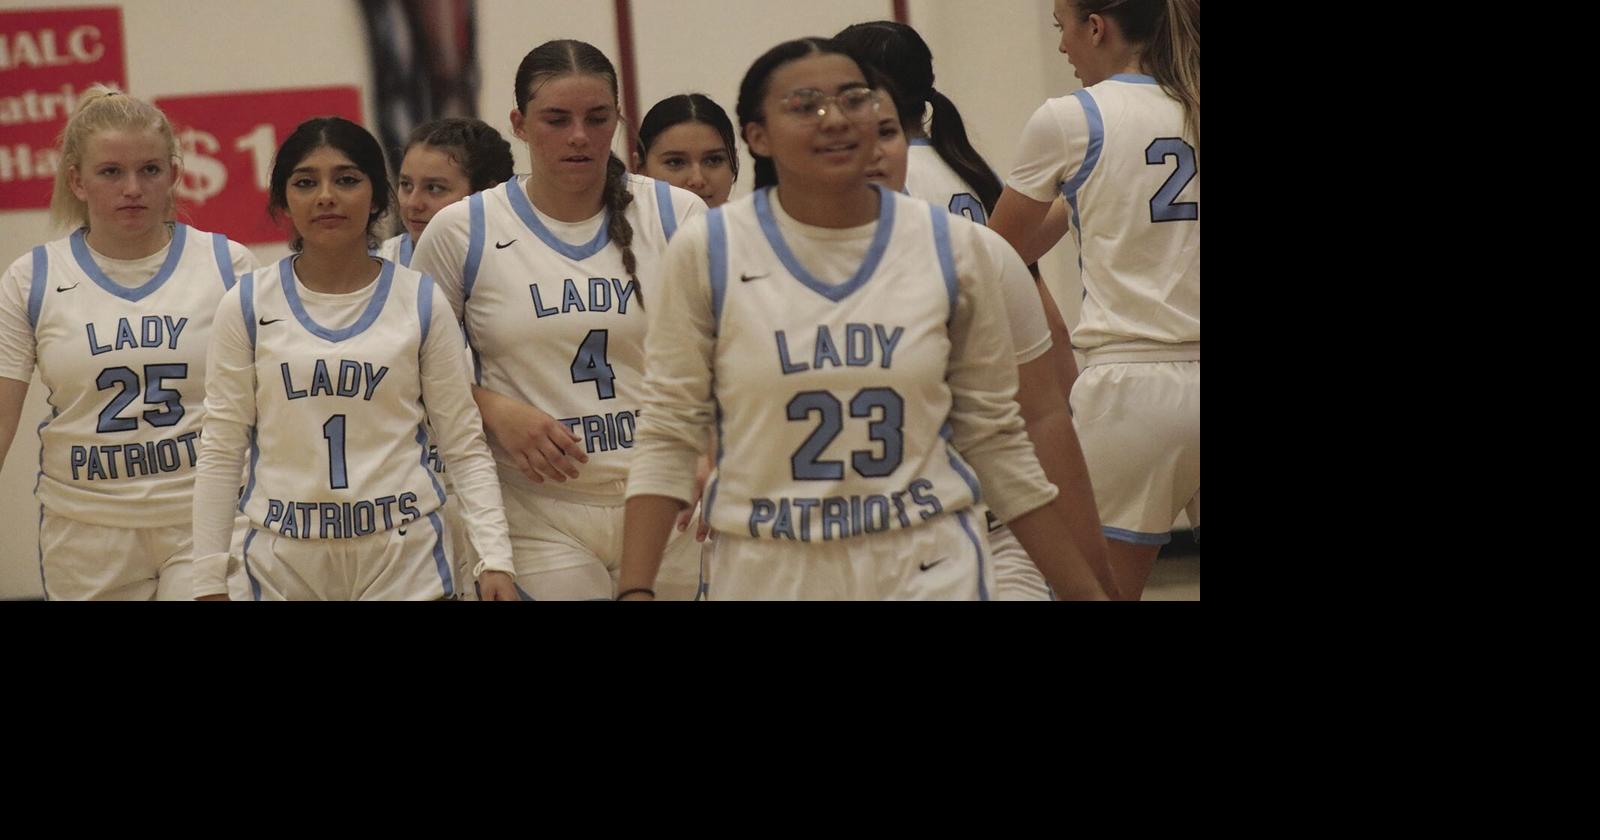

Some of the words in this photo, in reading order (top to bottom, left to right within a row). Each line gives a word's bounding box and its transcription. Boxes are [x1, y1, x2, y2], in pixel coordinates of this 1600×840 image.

[529, 278, 635, 318] LADY
[86, 315, 188, 356] LADY
[775, 323, 904, 375] LADY
[281, 359, 389, 400] LADY
[570, 329, 616, 400] 4
[96, 363, 188, 433] 25
[71, 431, 202, 480] PATRIOT
[323, 414, 349, 489] 1
[557, 409, 641, 454] TRIO
[786, 387, 905, 482] 23
[263, 492, 420, 539] PATRIOTS
[750, 477, 943, 542] PATRIOTS
